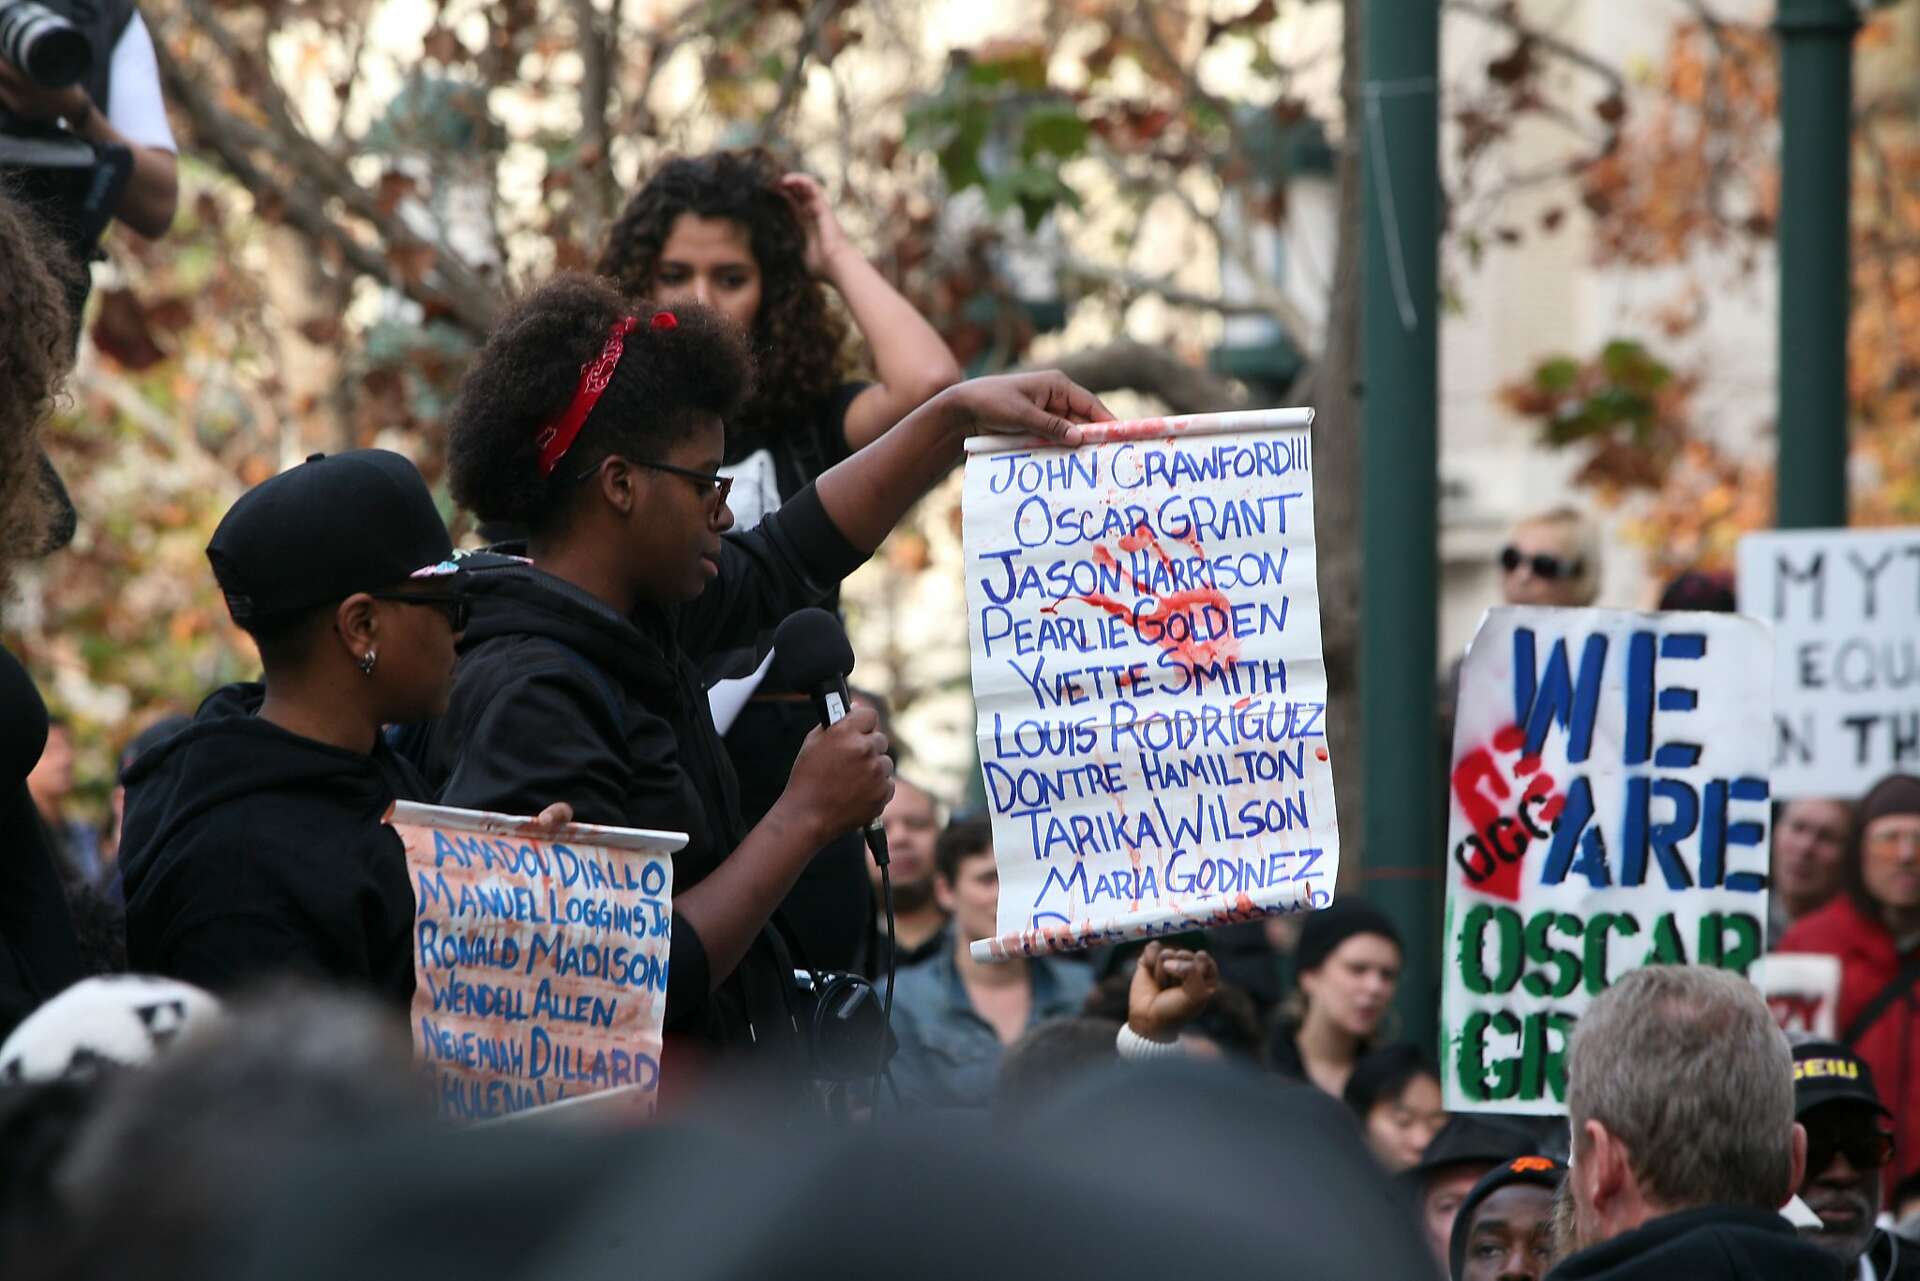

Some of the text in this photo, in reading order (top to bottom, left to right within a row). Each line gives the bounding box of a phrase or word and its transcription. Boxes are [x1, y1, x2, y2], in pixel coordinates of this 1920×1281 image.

[989, 451, 1097, 494] JOHN
[1014, 492, 1303, 547] OSCAR GRANT
[978, 547, 1288, 605] JASON HARRISON
[981, 596, 1289, 657] PEARLIE GOLDEN
[1008, 648, 1287, 709] YVETTE SMITH
[1513, 626, 1707, 768] WE
[994, 700, 1324, 759] LOUIS RODRIGUEZ
[983, 742, 1304, 813] DONTRE HAMILTON
[1010, 790, 1309, 860] TARIKA WILSON
[1541, 776, 1769, 891] ARE
[433, 831, 666, 896] AMADOU DIALLO
[1034, 848, 1323, 908] MARIA GODINEZ
[417, 870, 546, 924] MANUEL
[550, 889, 646, 940] LOGGINS
[418, 919, 668, 993] RONALD MADISON
[1460, 904, 1763, 998] OSCAR
[426, 971, 617, 1029] WENDELL ALLEN
[421, 1016, 523, 1077] NEHEMIAH
[528, 1025, 658, 1093] DILLARD
